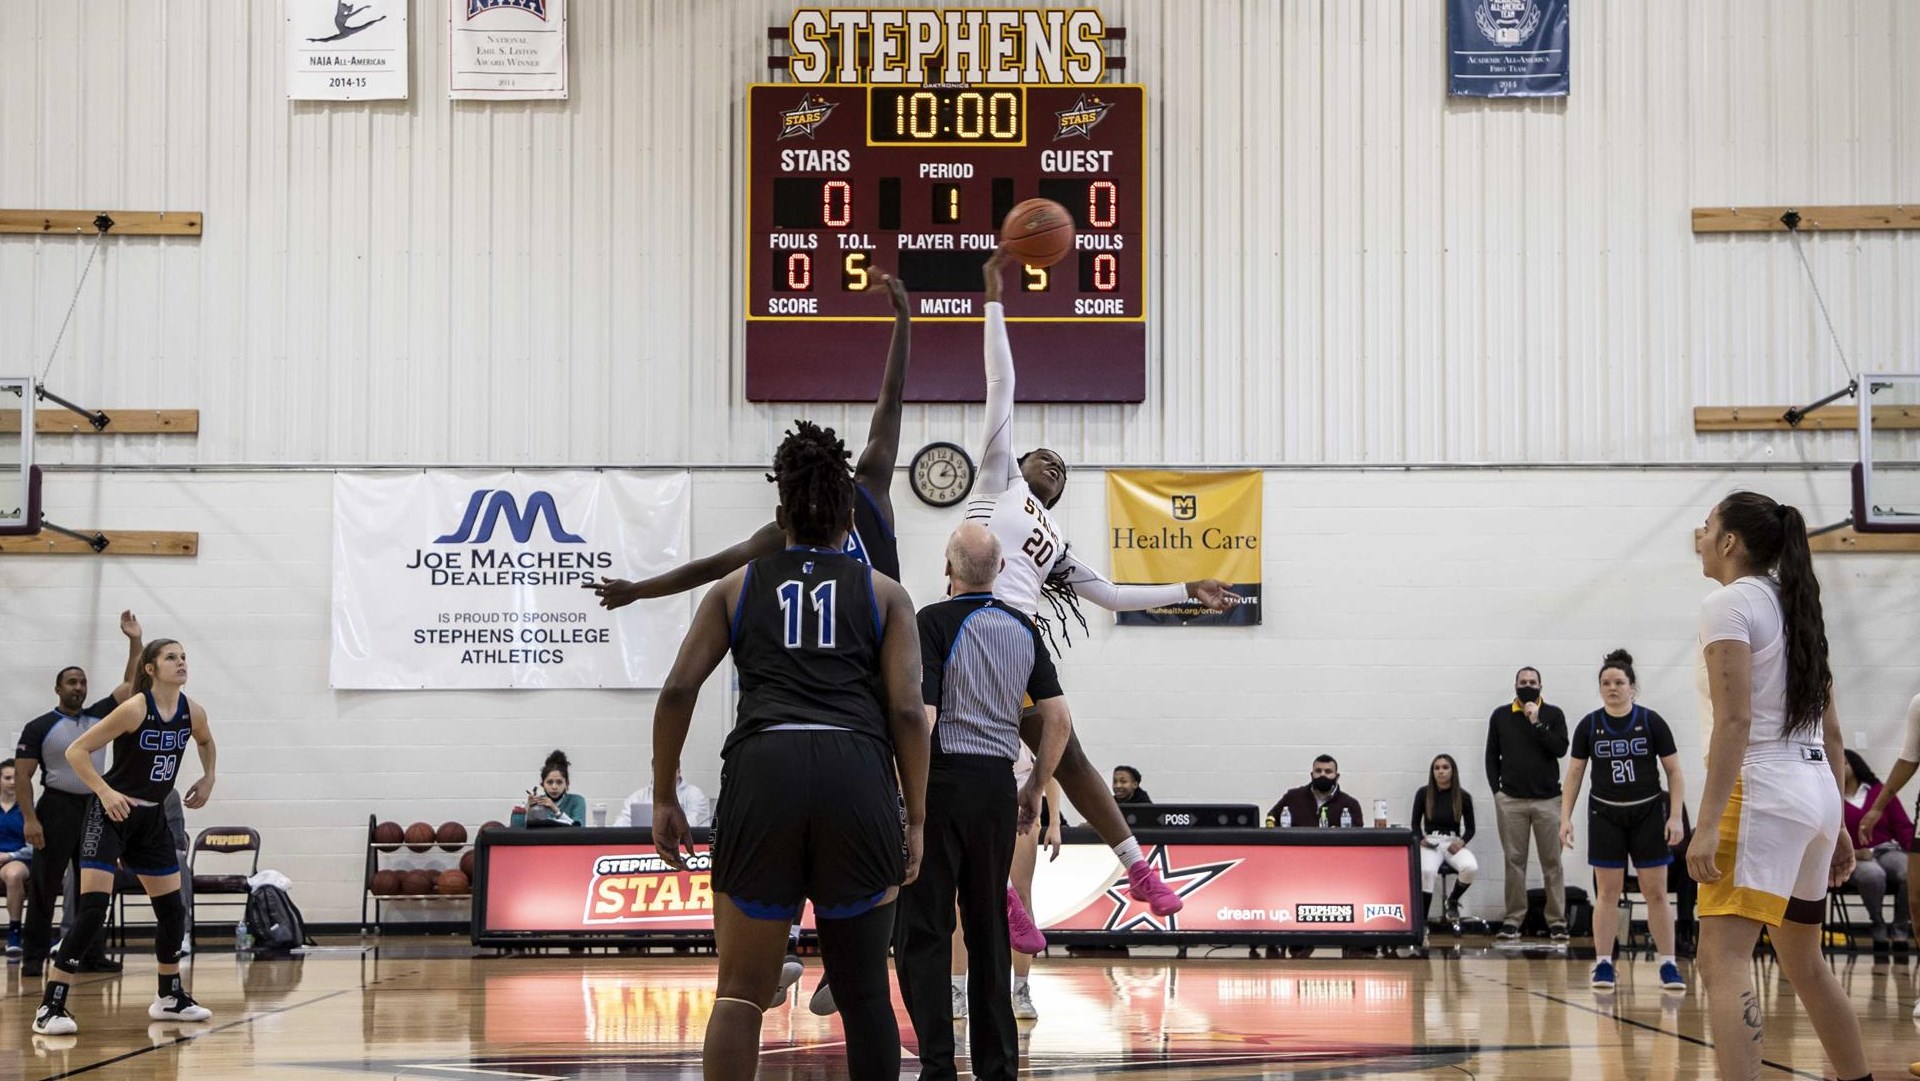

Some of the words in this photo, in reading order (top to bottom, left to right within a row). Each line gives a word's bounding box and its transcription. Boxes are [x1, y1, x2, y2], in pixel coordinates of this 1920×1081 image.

[790, 8, 1106, 84] STEPHENS
[309, 56, 332, 66] NAIA
[329, 77, 367, 88] 2014-15
[785, 112, 821, 126] STARS
[896, 92, 1017, 138] 10:00
[1060, 112, 1097, 127] STARS
[780, 149, 851, 172] STARS
[1040, 149, 1114, 173] GUEST
[919, 163, 974, 179] PERIOD
[823, 181, 851, 227] 0
[950, 188, 959, 220] 1
[1089, 181, 1116, 228] 0
[769, 233, 818, 249] FOULS
[836, 233, 877, 250] T.O.L.
[897, 233, 954, 249] PLAYER
[1075, 234, 1124, 249] FOULS
[788, 253, 811, 289] 0
[845, 253, 868, 291] 5
[1094, 253, 1117, 290] 0
[768, 298, 818, 314] SCORE
[920, 298, 972, 314] MATCH
[1074, 298, 1124, 314] SCORE
[1111, 526, 1193, 550] Health
[1201, 527, 1258, 550] Care
[1021, 527, 1054, 568] 20
[406, 549, 462, 569] JOE
[471, 549, 613, 569] MACHENS
[431, 569, 595, 586] DEALERSHIPS
[438, 612, 450, 623] IS
[454, 612, 500, 623] PROUD
[503, 612, 519, 623] TO
[522, 612, 587, 623] SPONSOR
[776, 579, 837, 649] 11
[413, 628, 514, 644] STEPHENS
[520, 628, 610, 643] COLLEGE
[460, 650, 564, 664] ATHLETICS
[139, 728, 191, 750] CBC
[1594, 737, 1648, 758] CBC
[150, 754, 177, 782] 20
[1611, 759, 1636, 783] 21
[1165, 814, 1190, 825] POSS
[598, 858, 677, 873] STEPHEN
[595, 874, 714, 914] STAR
[1217, 906, 1265, 921] dream
[1269, 908, 1293, 923] up.
[1298, 905, 1352, 915] STEPHENS
[1365, 906, 1404, 919] NAIA
